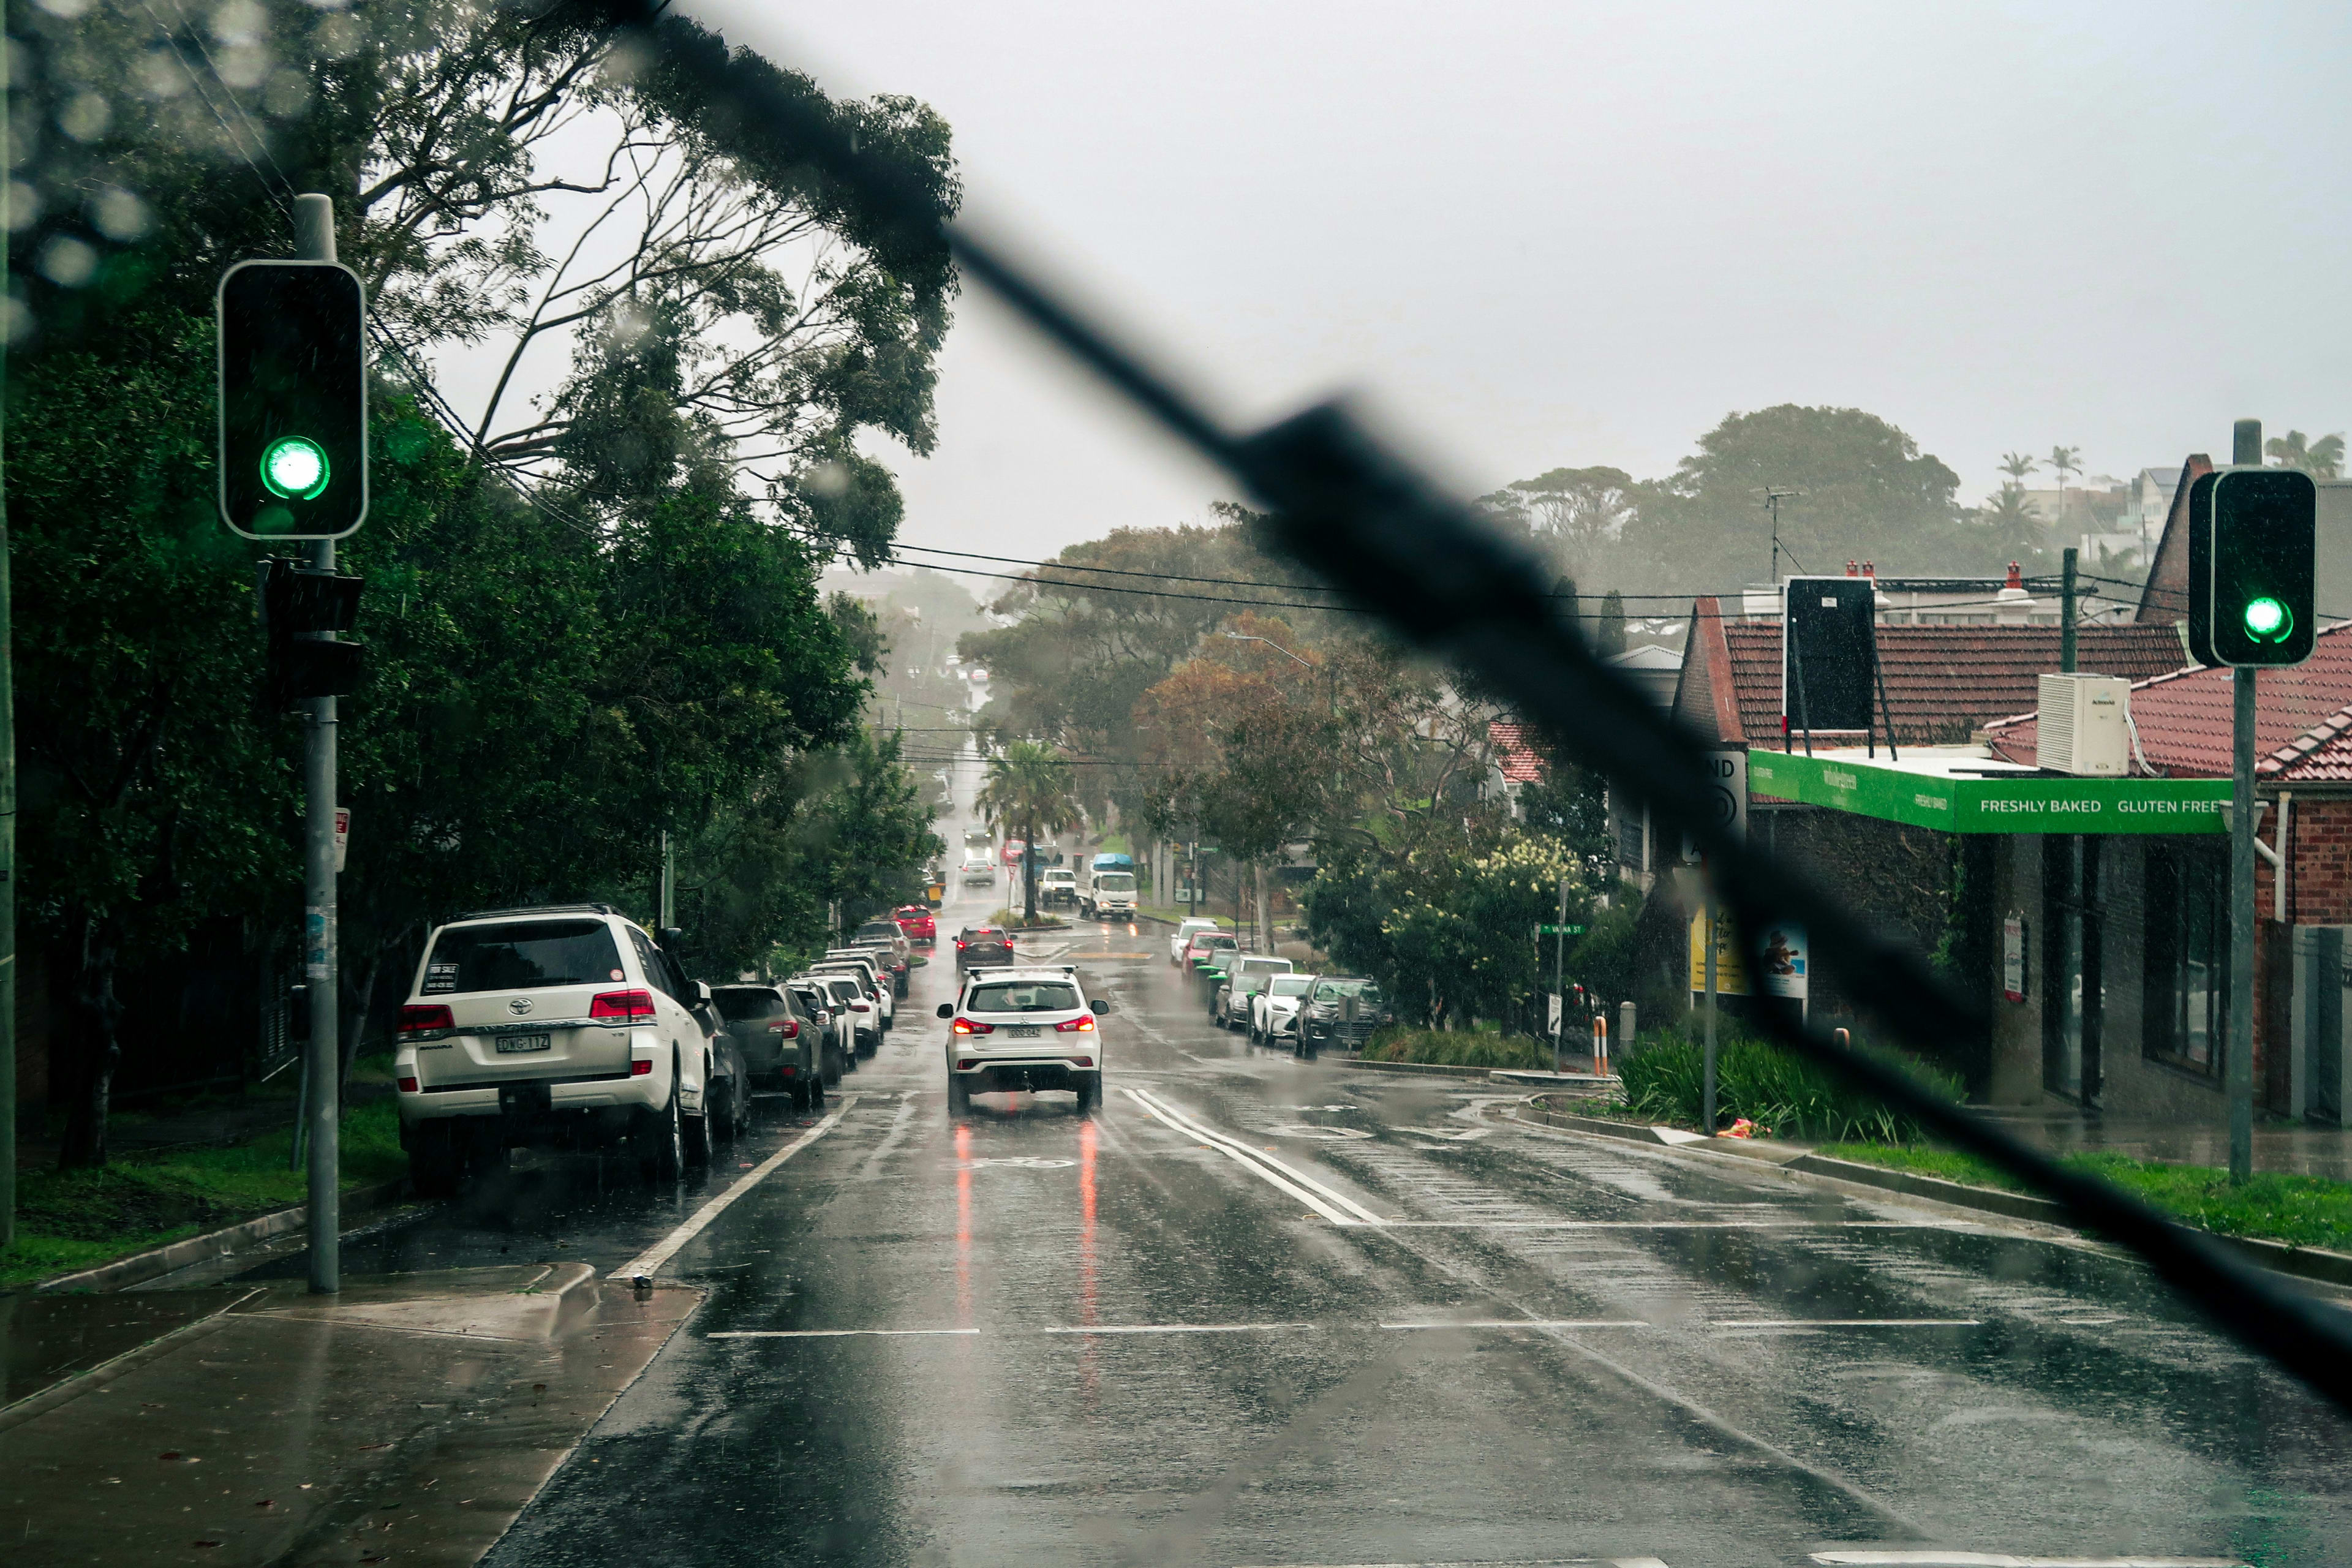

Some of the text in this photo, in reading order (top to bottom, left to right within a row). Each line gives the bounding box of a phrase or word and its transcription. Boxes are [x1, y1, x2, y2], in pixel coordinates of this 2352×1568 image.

[1705, 759, 1735, 778] ND
[1981, 799, 2220, 813] FRESHLY BAKED GLUTEN FREE
[1574, 925, 1581, 934] ST
